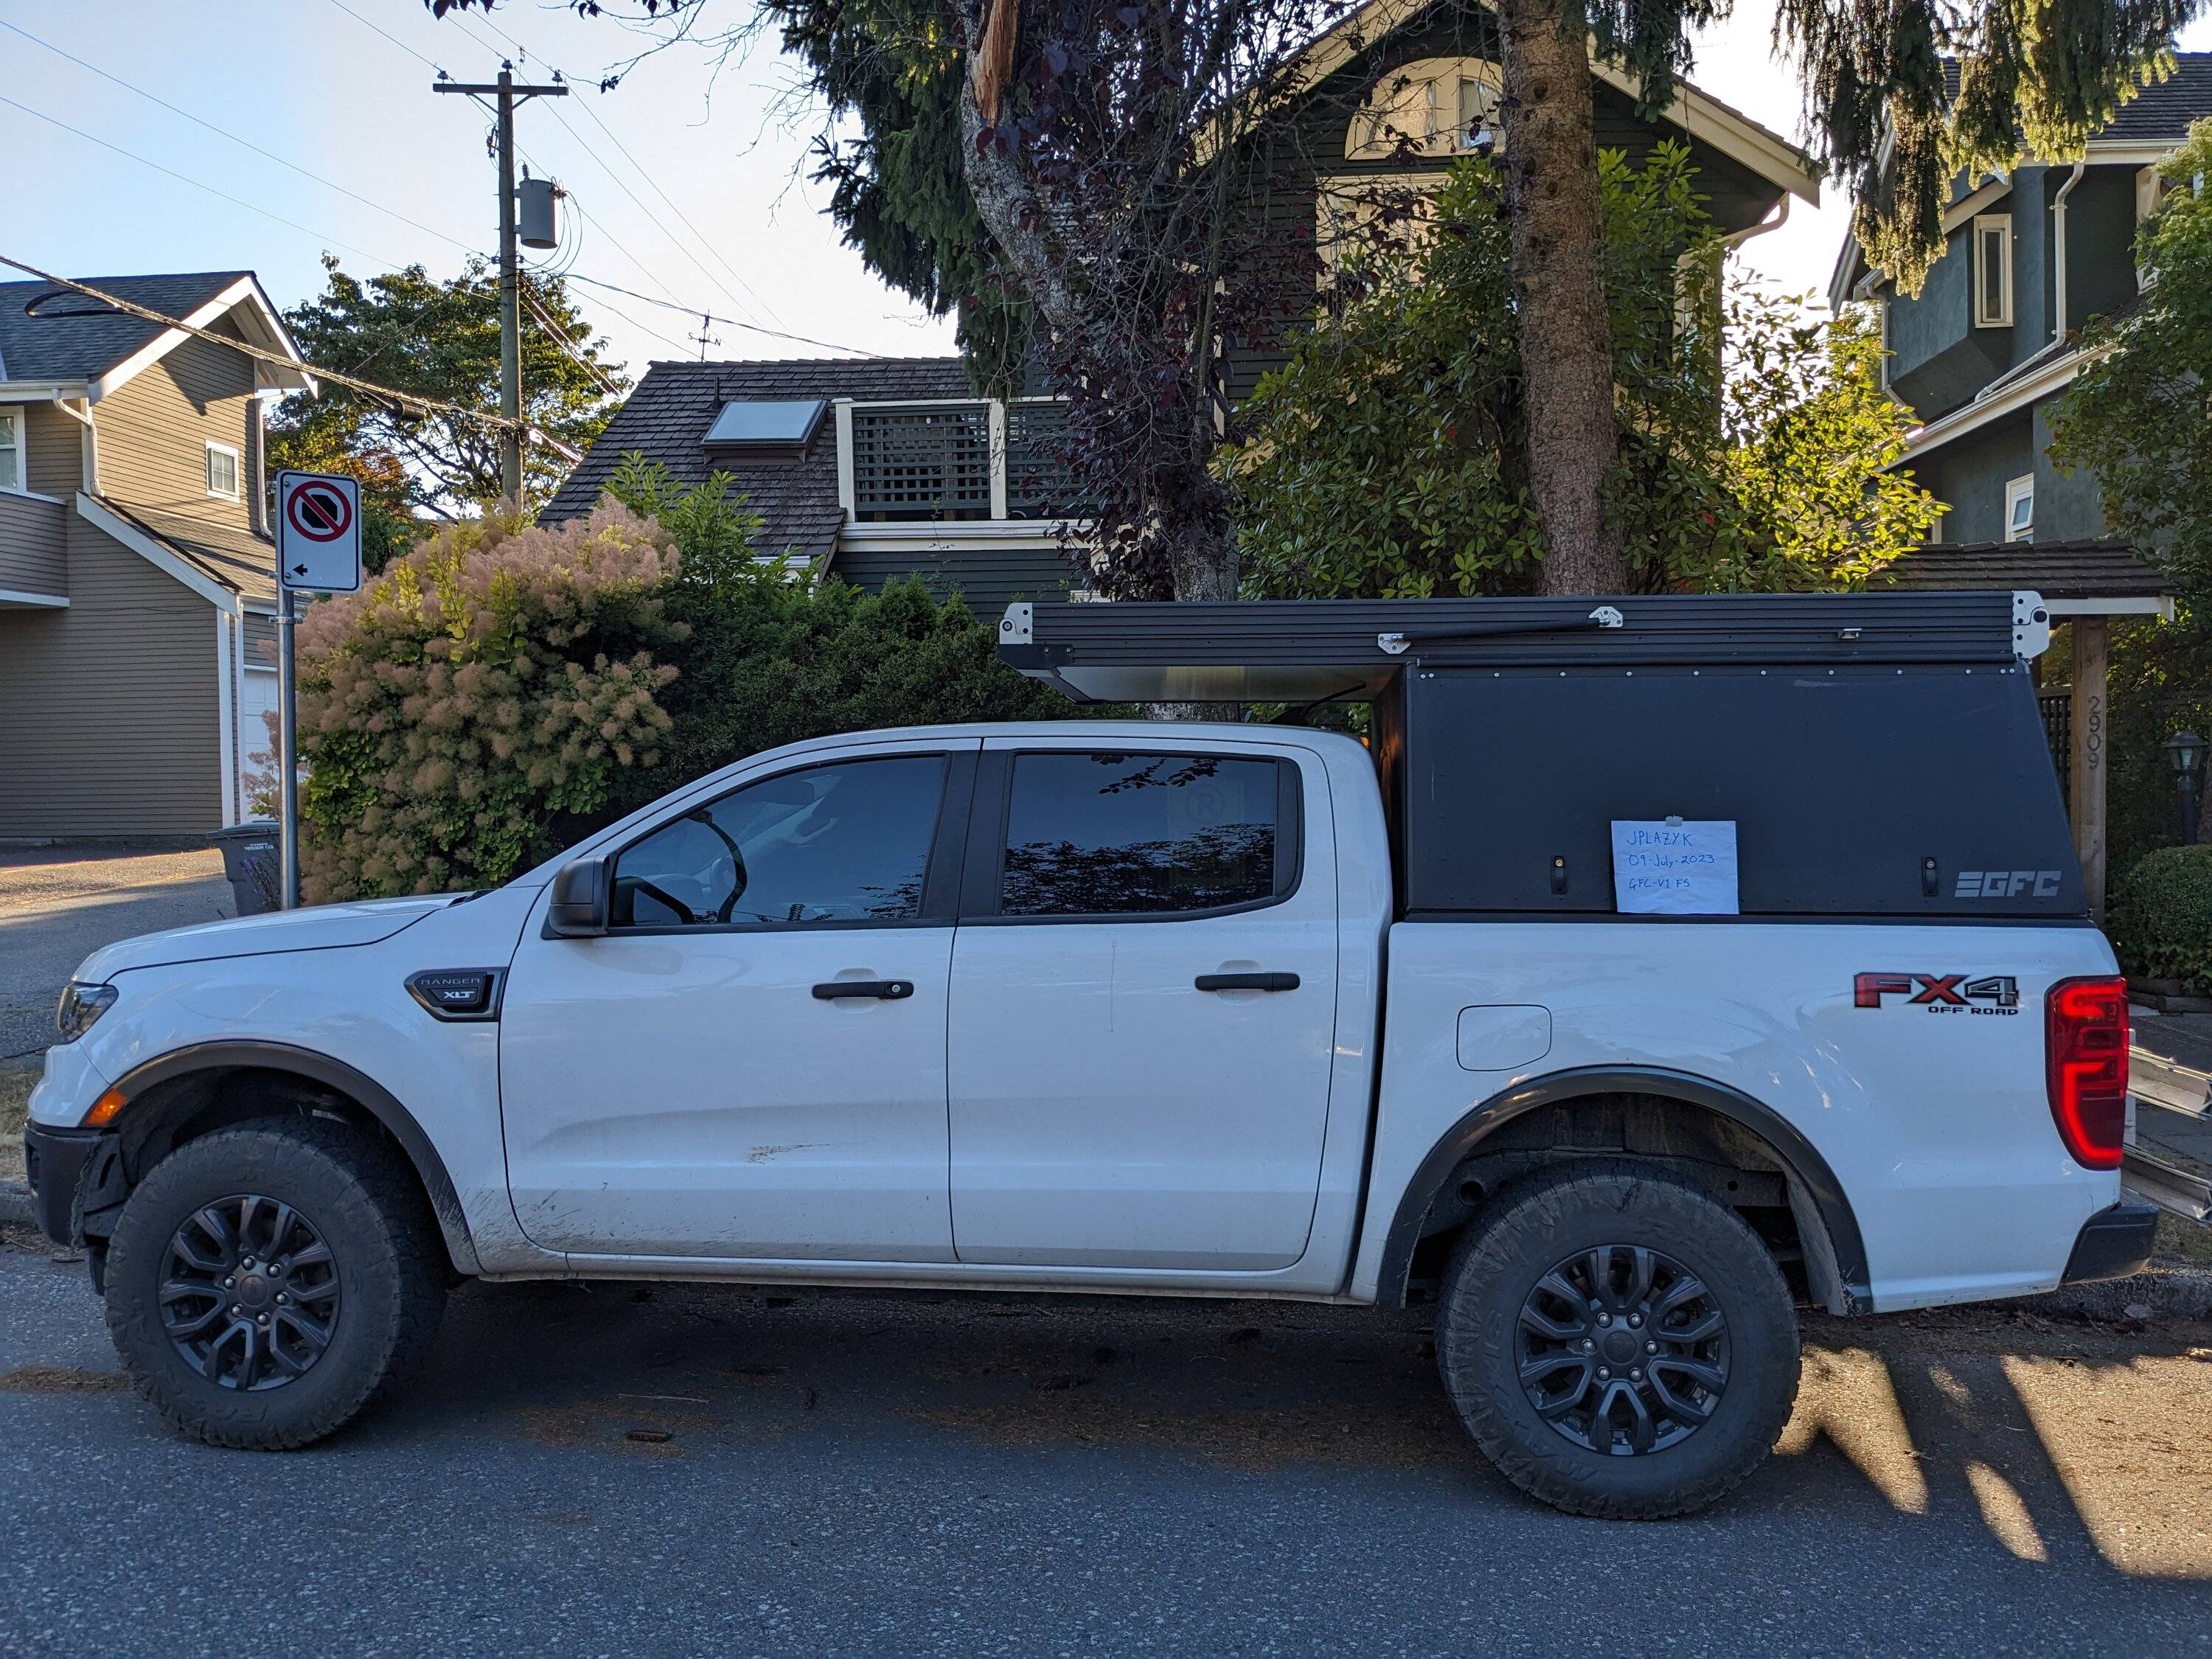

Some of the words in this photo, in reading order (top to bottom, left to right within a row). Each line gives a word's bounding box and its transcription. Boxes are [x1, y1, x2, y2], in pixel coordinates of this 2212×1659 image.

[687, 332, 694, 341] S
[714, 338, 722, 347] N
[2087, 695, 2101, 770] 2909
[1676, 878, 1691, 888] FS
[1853, 971, 2020, 1009] FX4
[443, 991, 475, 999] XLT
[1927, 1006, 1964, 1014] OFF
[1970, 1007, 2019, 1015] ROAD
